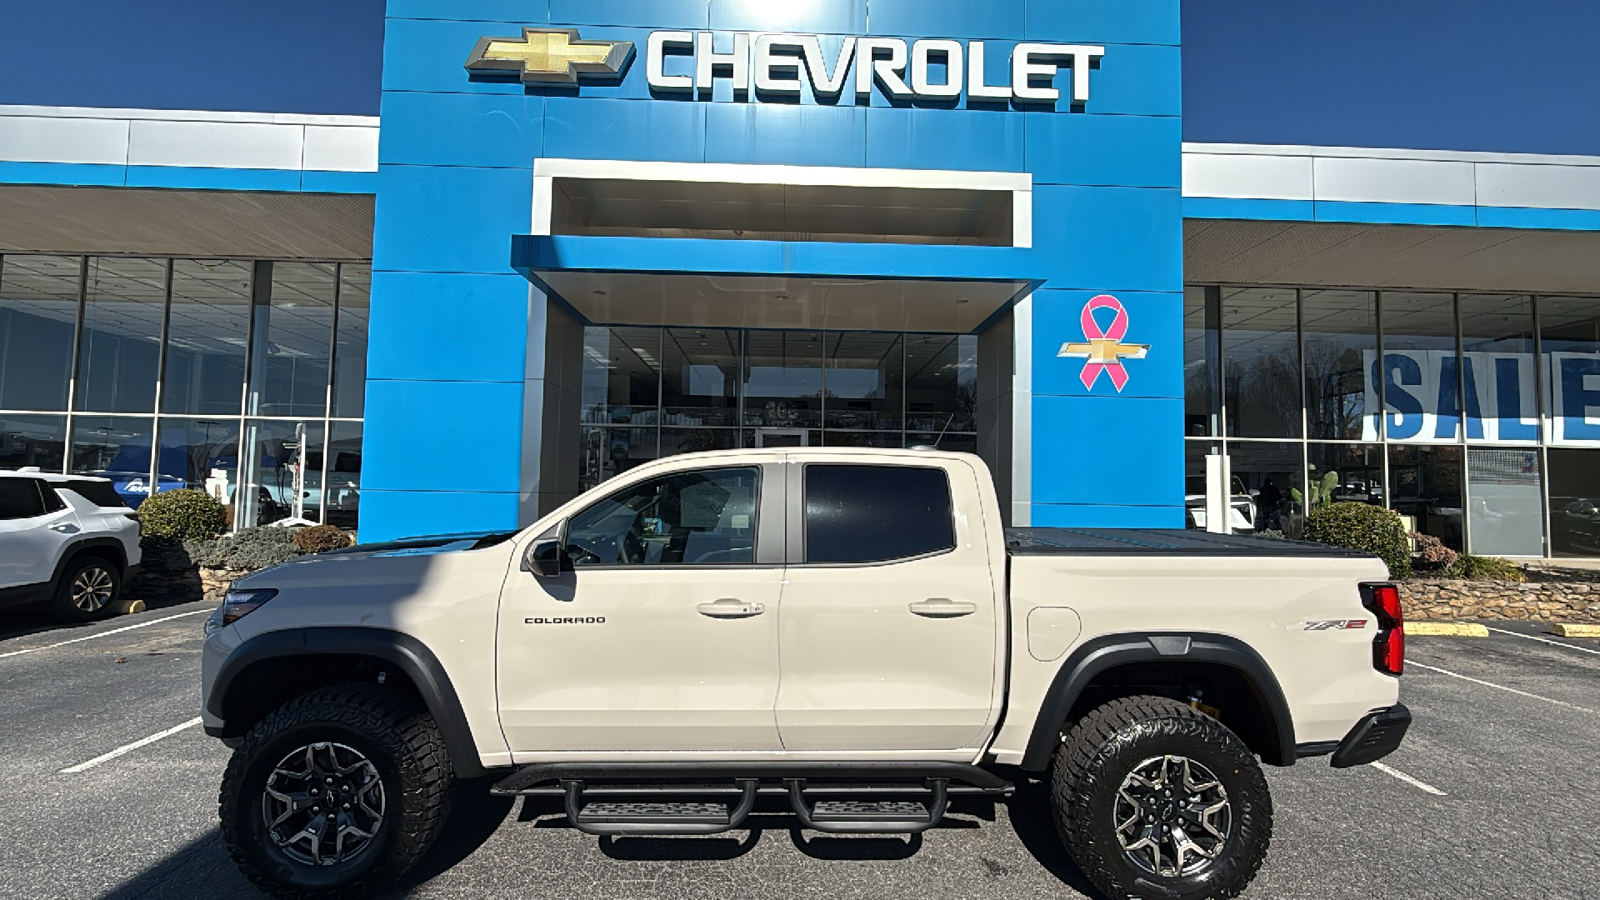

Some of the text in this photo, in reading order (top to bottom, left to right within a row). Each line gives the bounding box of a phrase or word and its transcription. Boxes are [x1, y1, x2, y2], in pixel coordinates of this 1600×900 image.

[647, 31, 1105, 107] CHEVROLET
[1371, 353, 1600, 441] SALE
[524, 616, 606, 624] COLORADO
[1303, 619, 1368, 631] ZR2
